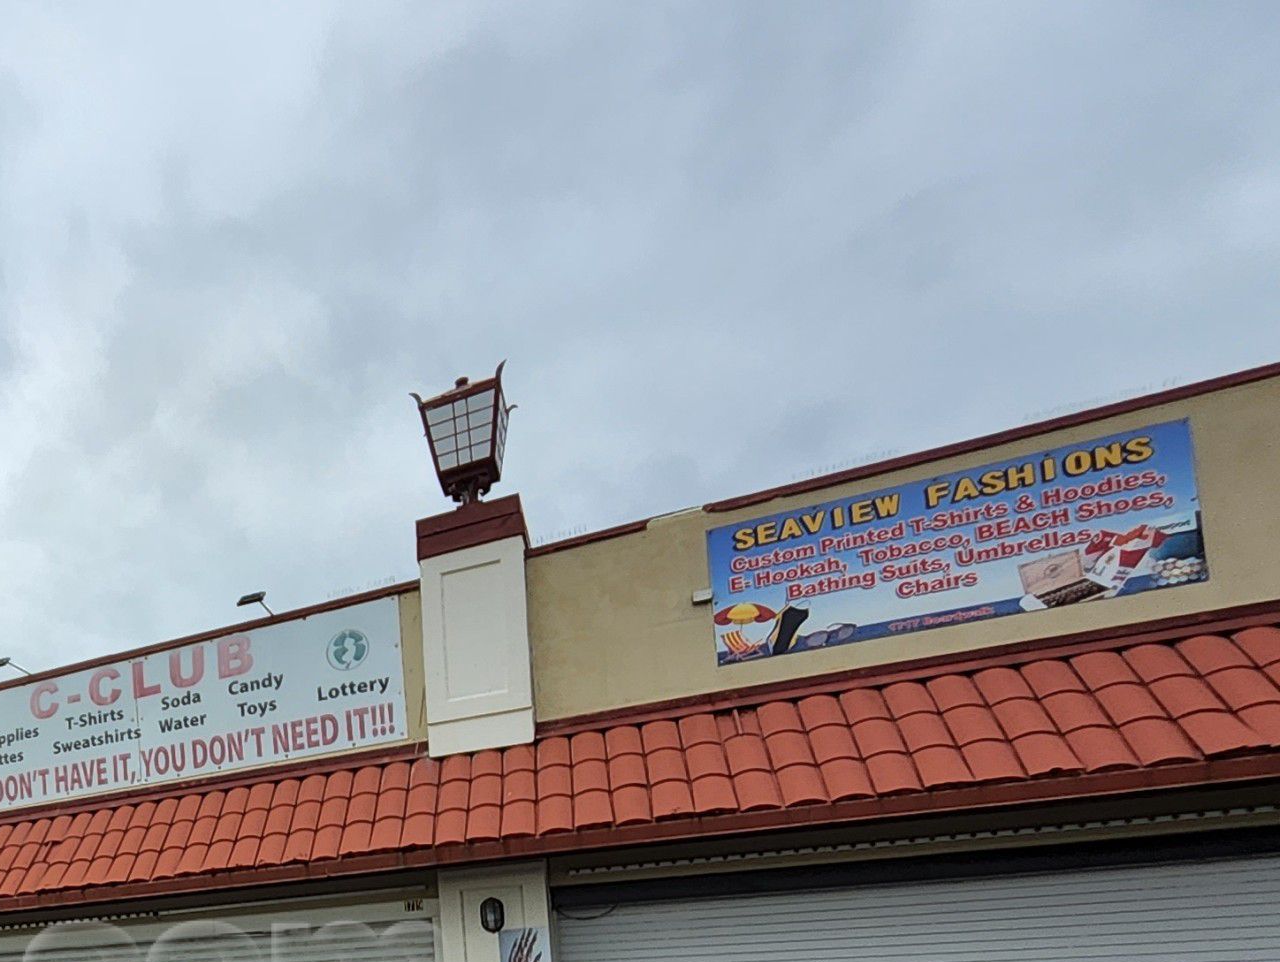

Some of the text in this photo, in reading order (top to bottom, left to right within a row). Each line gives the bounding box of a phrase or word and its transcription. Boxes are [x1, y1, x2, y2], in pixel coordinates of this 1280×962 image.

[732, 435, 1155, 551] SEAVIEW FASHIONS
[730, 470, 1167, 574] Custom Printed T-Shirts & Hoodies,
[755, 555, 849, 589] Hookah,
[859, 530, 973, 566] Tobacco,
[976, 507, 1071, 543] BEACH
[1075, 488, 1175, 523] Shoes,
[786, 526, 1103, 602] Bathing Suits, Umbrellas,
[896, 570, 979, 600] Chairs
[923, 605, 996, 626] Boardwalk
[30, 635, 254, 720] C-CLUB
[228, 671, 284, 697] Candy
[317, 674, 390, 702] Lottery
[161, 690, 202, 711] Soda
[237, 697, 277, 718] Toys
[65, 708, 124, 731] T-Shirts
[158, 712, 207, 734] Water
[53, 727, 141, 755] Sweatshirts
[55, 758, 107, 794] HAVE
[111, 752, 138, 786] IT,
[140, 746, 186, 778] YOU
[191, 726, 266, 767] DON'T
[271, 713, 339, 753] NEED
[345, 701, 396, 742] IT!!!
